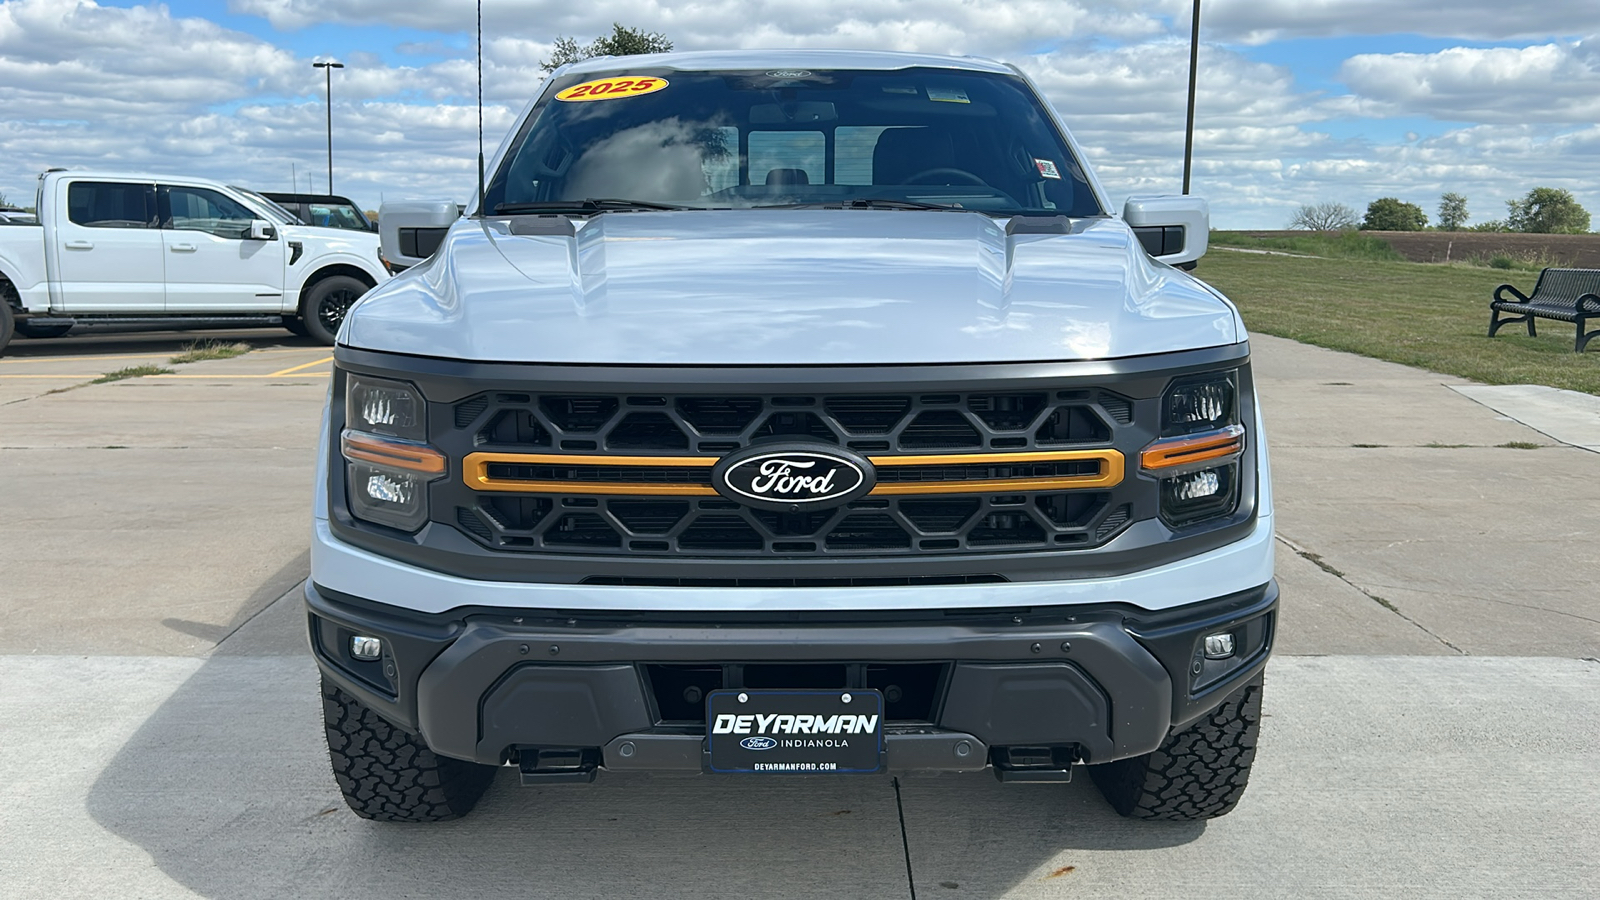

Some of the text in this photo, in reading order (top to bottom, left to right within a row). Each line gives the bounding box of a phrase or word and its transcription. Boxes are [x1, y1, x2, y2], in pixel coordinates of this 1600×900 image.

[565, 79, 657, 99] 2025
[751, 459, 837, 494] Ford
[712, 713, 879, 734] DEYARMAN
[747, 738, 849, 749] Ford INDIANOLA
[754, 763, 837, 771] DEYARMANFORD.COM
